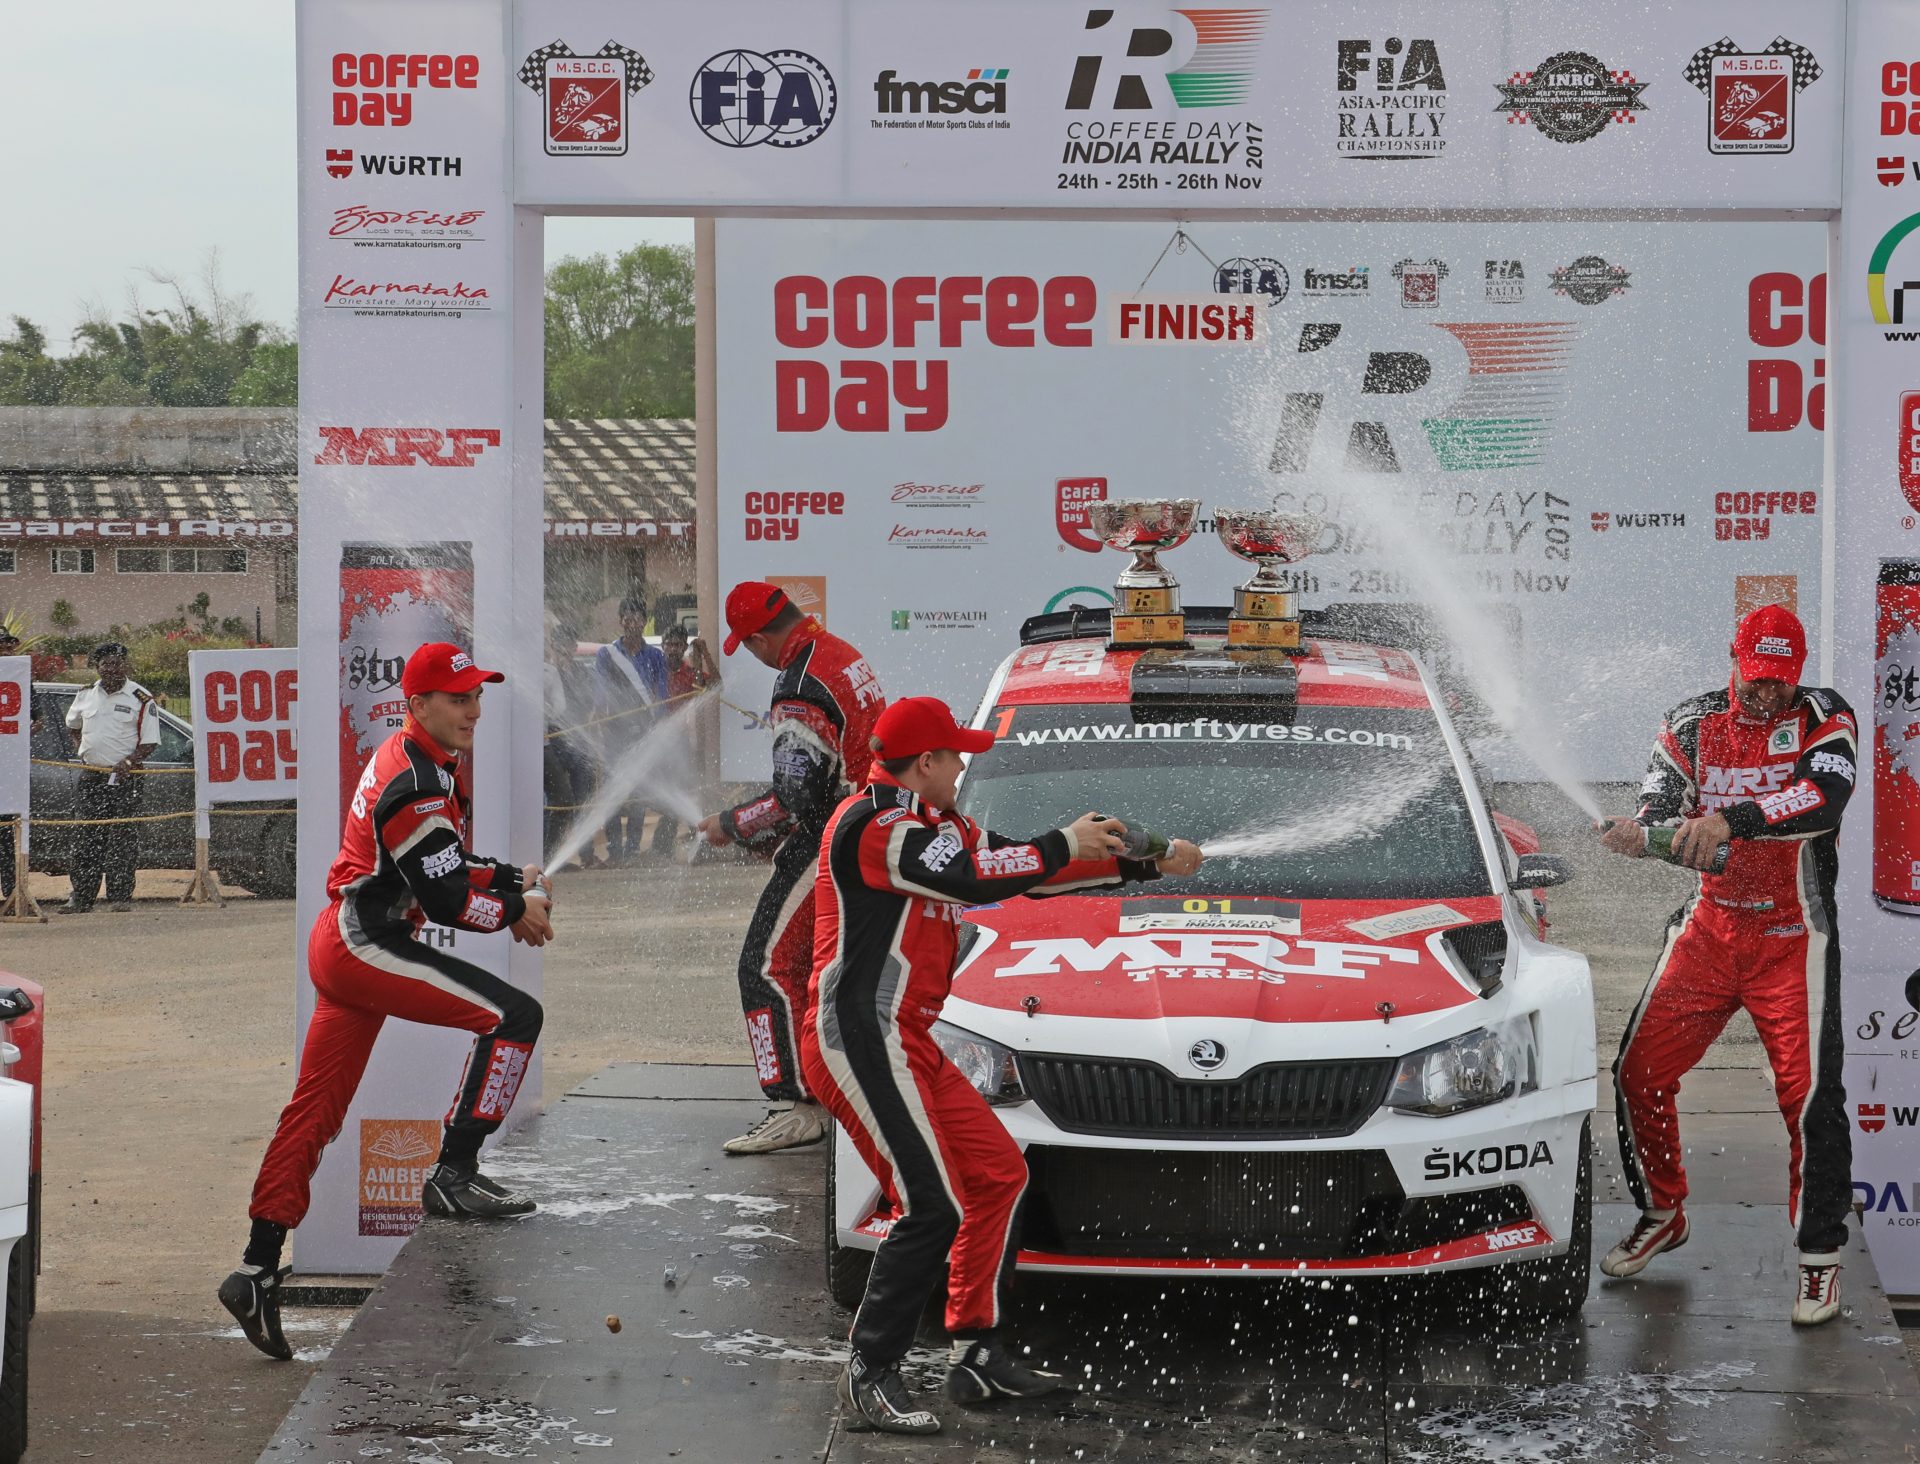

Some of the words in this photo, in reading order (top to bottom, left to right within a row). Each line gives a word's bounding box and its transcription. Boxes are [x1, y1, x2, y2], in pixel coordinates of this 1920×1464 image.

[556, 63, 615, 73] M.S.C.C.
[1723, 59, 1783, 70] M.S.C.C.
[874, 69, 1009, 114] fmsci
[1338, 96, 1446, 109] ASIA-PACIFIC
[871, 120, 882, 128] The
[884, 120, 917, 129] Federation
[918, 120, 925, 128] of
[926, 120, 945, 128] Motor
[946, 120, 967, 130] Sports
[968, 120, 986, 129] Clubs
[987, 120, 994, 128] of
[995, 120, 1011, 129] India
[1338, 113, 1446, 137] RALLY
[1559, 112, 1583, 121] 2017
[1066, 121, 1175, 140] COFFEE
[1187, 121, 1243, 139] DAY
[1062, 142, 1141, 164] INDIA
[1150, 142, 1240, 164] RALLY
[1246, 123, 1263, 169] 2017
[1337, 140, 1446, 151] CHAMPIONSHIP
[1057, 173, 1099, 190] 24th
[1117, 173, 1158, 190] 25th
[1177, 173, 1218, 190] 26th
[1225, 173, 1263, 190] Nov
[354, 241, 461, 249] www.karnatakatourism.org
[324, 275, 491, 303] Karnataka
[405, 298, 437, 308] Many
[354, 309, 462, 318] www.karnatakatourism.org
[1120, 303, 1254, 341] FINISH
[314, 427, 501, 467] MRF
[1455, 491, 1537, 518] DAY
[888, 524, 988, 542] Karnataka
[1544, 491, 1571, 562] 2017
[369, 555, 395, 566] BOLT
[1513, 569, 1570, 592] Nov
[914, 611, 987, 622] WAY2WEALTH
[1016, 717, 1413, 752] www.mrftyres.com
[1700, 762, 1795, 794] MRF
[1764, 789, 1822, 819] TYRES
[879, 809, 906, 825] ŠKODA
[421, 842, 460, 870] MRF
[979, 855, 1040, 876] TYRES
[469, 895, 502, 916] MRF
[1183, 899, 1232, 914] 01
[464, 911, 501, 930] TYRES
[994, 932, 1420, 980] MRF
[1127, 967, 1287, 985] TYRES
[479, 1046, 514, 1115] TYRES
[1424, 1140, 1554, 1181] ŠKODA
[364, 1185, 421, 1202] VALLE
[362, 1213, 406, 1221] RESIDENTIAL
[408, 1213, 423, 1221] SCH
[1485, 1226, 1538, 1250] MRF
